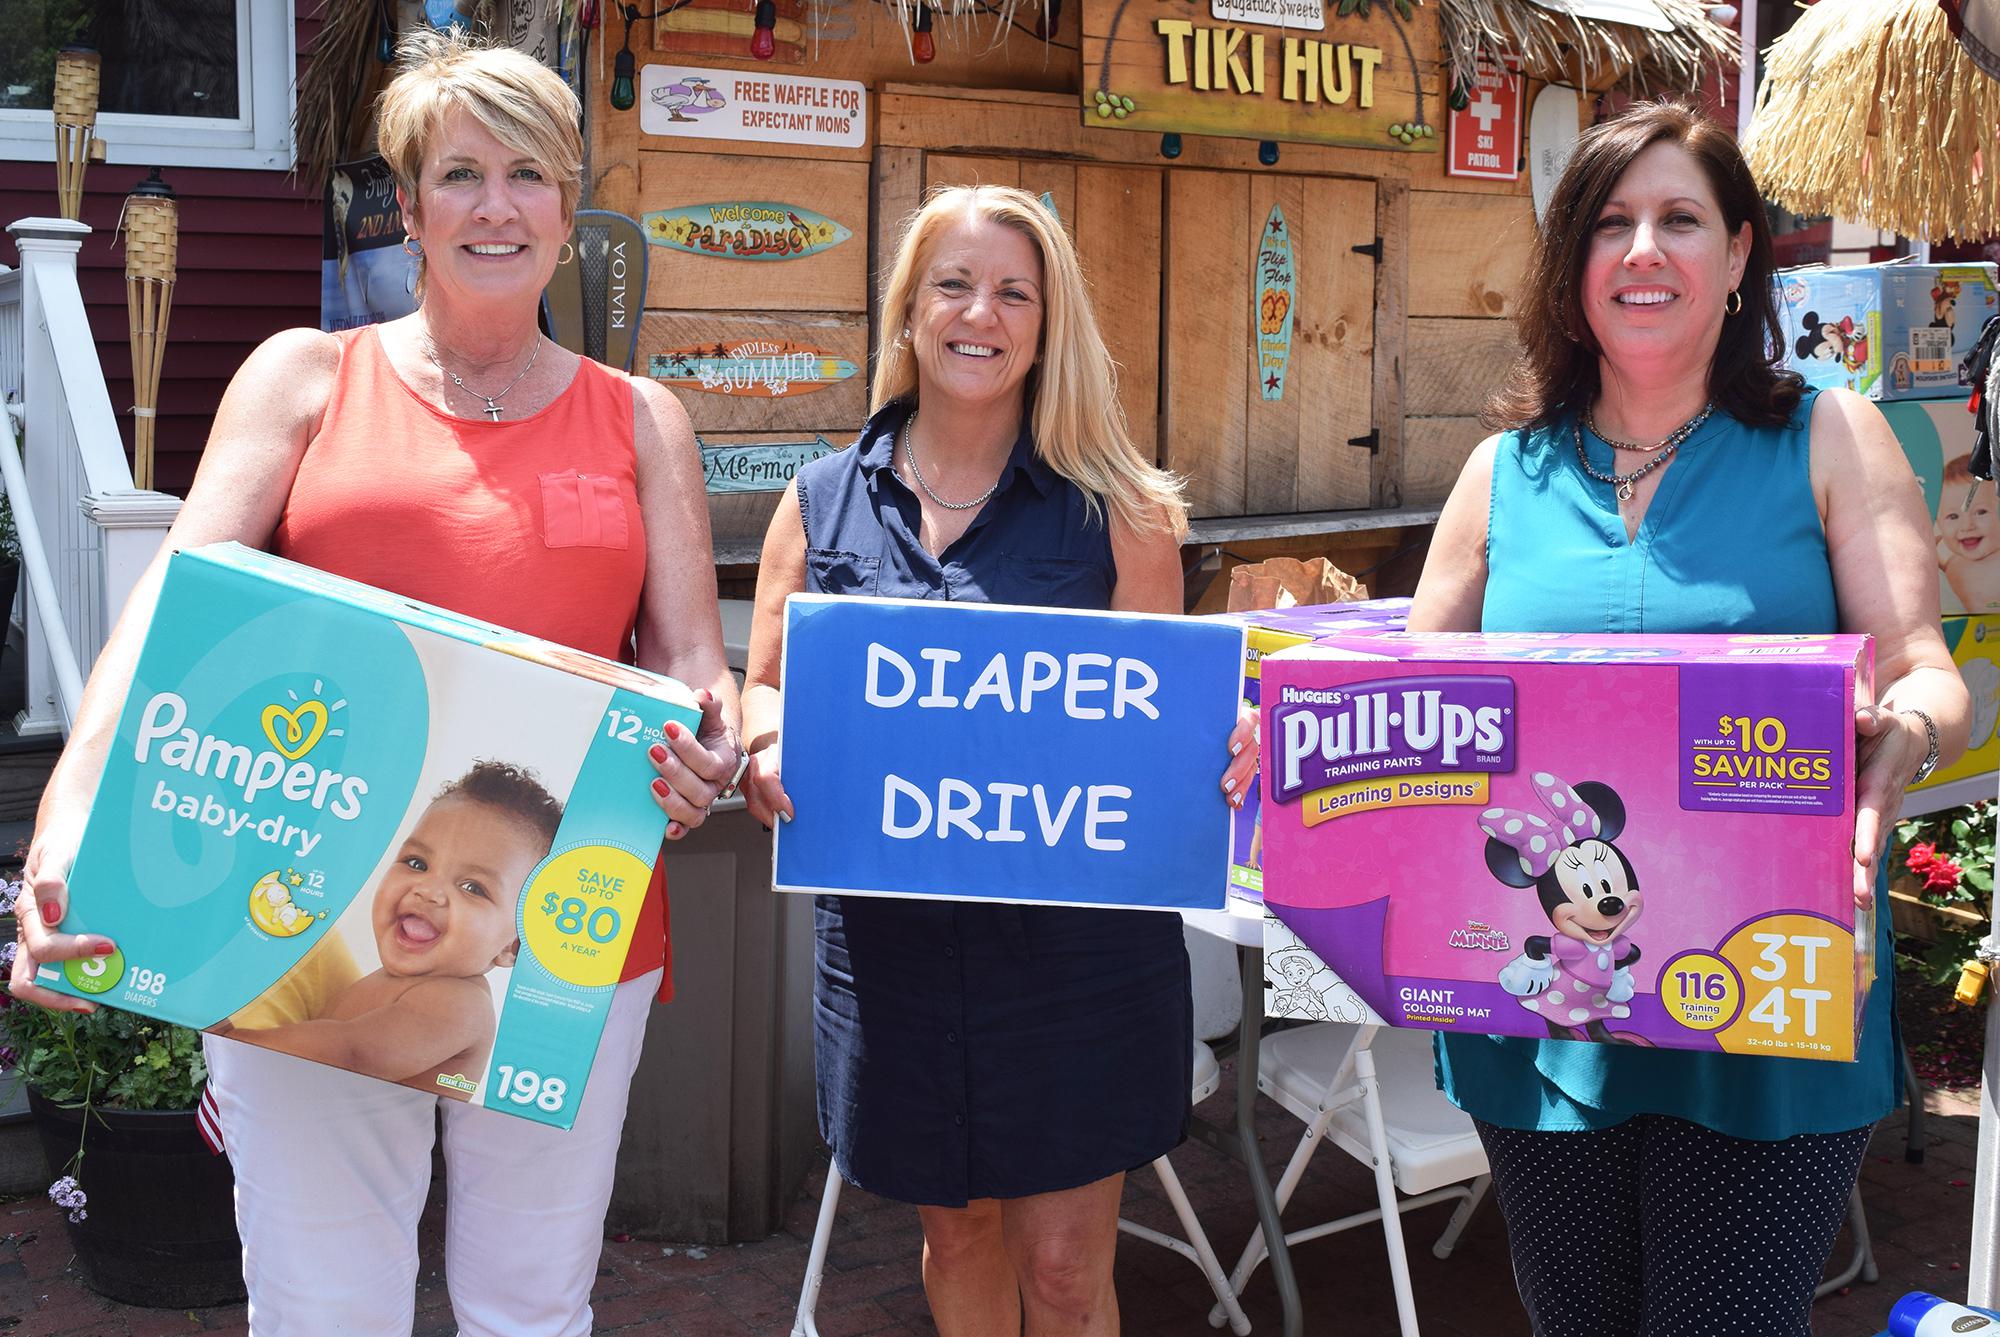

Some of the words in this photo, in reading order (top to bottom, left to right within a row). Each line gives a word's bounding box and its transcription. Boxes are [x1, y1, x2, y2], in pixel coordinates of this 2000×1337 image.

[1280, 0, 1320, 19] Sweets
[1158, 19, 1265, 94] TIKI
[1283, 37, 1383, 108] HUT
[734, 80, 770, 103] FREE
[774, 84, 829, 108] WAFFLE
[833, 88, 860, 110] FOR
[742, 109, 812, 131] EXPECTANT
[815, 115, 851, 134] MOMS
[1477, 135, 1494, 149] SKI
[1467, 152, 1501, 168] PATROL
[709, 204, 785, 224] Welcome
[1261, 251, 1288, 268] Flip
[612, 241, 626, 328] KIALOA
[1265, 269, 1292, 286] Flop
[730, 341, 781, 363] ENDLESS
[723, 351, 820, 393] SUMMER
[1246, 648, 1260, 662] OX
[865, 642, 1160, 720] DIAPER
[607, 710, 643, 745] 12
[1718, 715, 1787, 754] $10
[134, 692, 369, 820] Pampers
[1324, 760, 1380, 778] TRAINING
[1383, 756, 1422, 769] PANTS
[1476, 755, 1501, 763] BRAND
[1693, 754, 1831, 781] SAVINGS
[1318, 786, 1392, 814] Learning
[151, 780, 322, 858] baby-dry
[882, 773, 1132, 851] DRIVE
[307, 872, 325, 889] 12
[577, 868, 625, 892] SAVE
[300, 887, 325, 898] HOURS
[580, 884, 597, 895] UP
[598, 888, 615, 900] TO
[541, 891, 621, 944] $80
[560, 942, 569, 950] A
[1448, 929, 1510, 951] MINNIE
[1750, 932, 1832, 984] 3T
[129, 966, 167, 995] 198
[1674, 971, 1727, 1001] 116
[124, 991, 158, 1007] DIAPERS
[1400, 987, 1455, 1004] GIANT
[1403, 1003, 1464, 1016] COLORING
[1467, 1007, 1491, 1018] MAT
[1406, 1014, 1431, 1022] Printed
[1680, 1002, 1720, 1014] Training
[1686, 1013, 1714, 1022] Pants
[1748, 986, 1832, 1037] 4T
[1747, 1038, 1773, 1047] 32-40
[1775, 1039, 1788, 1048] lbs
[1796, 1041, 1818, 1050] 15-18
[1820, 1042, 1831, 1052] kg
[498, 1065, 567, 1111] 198
